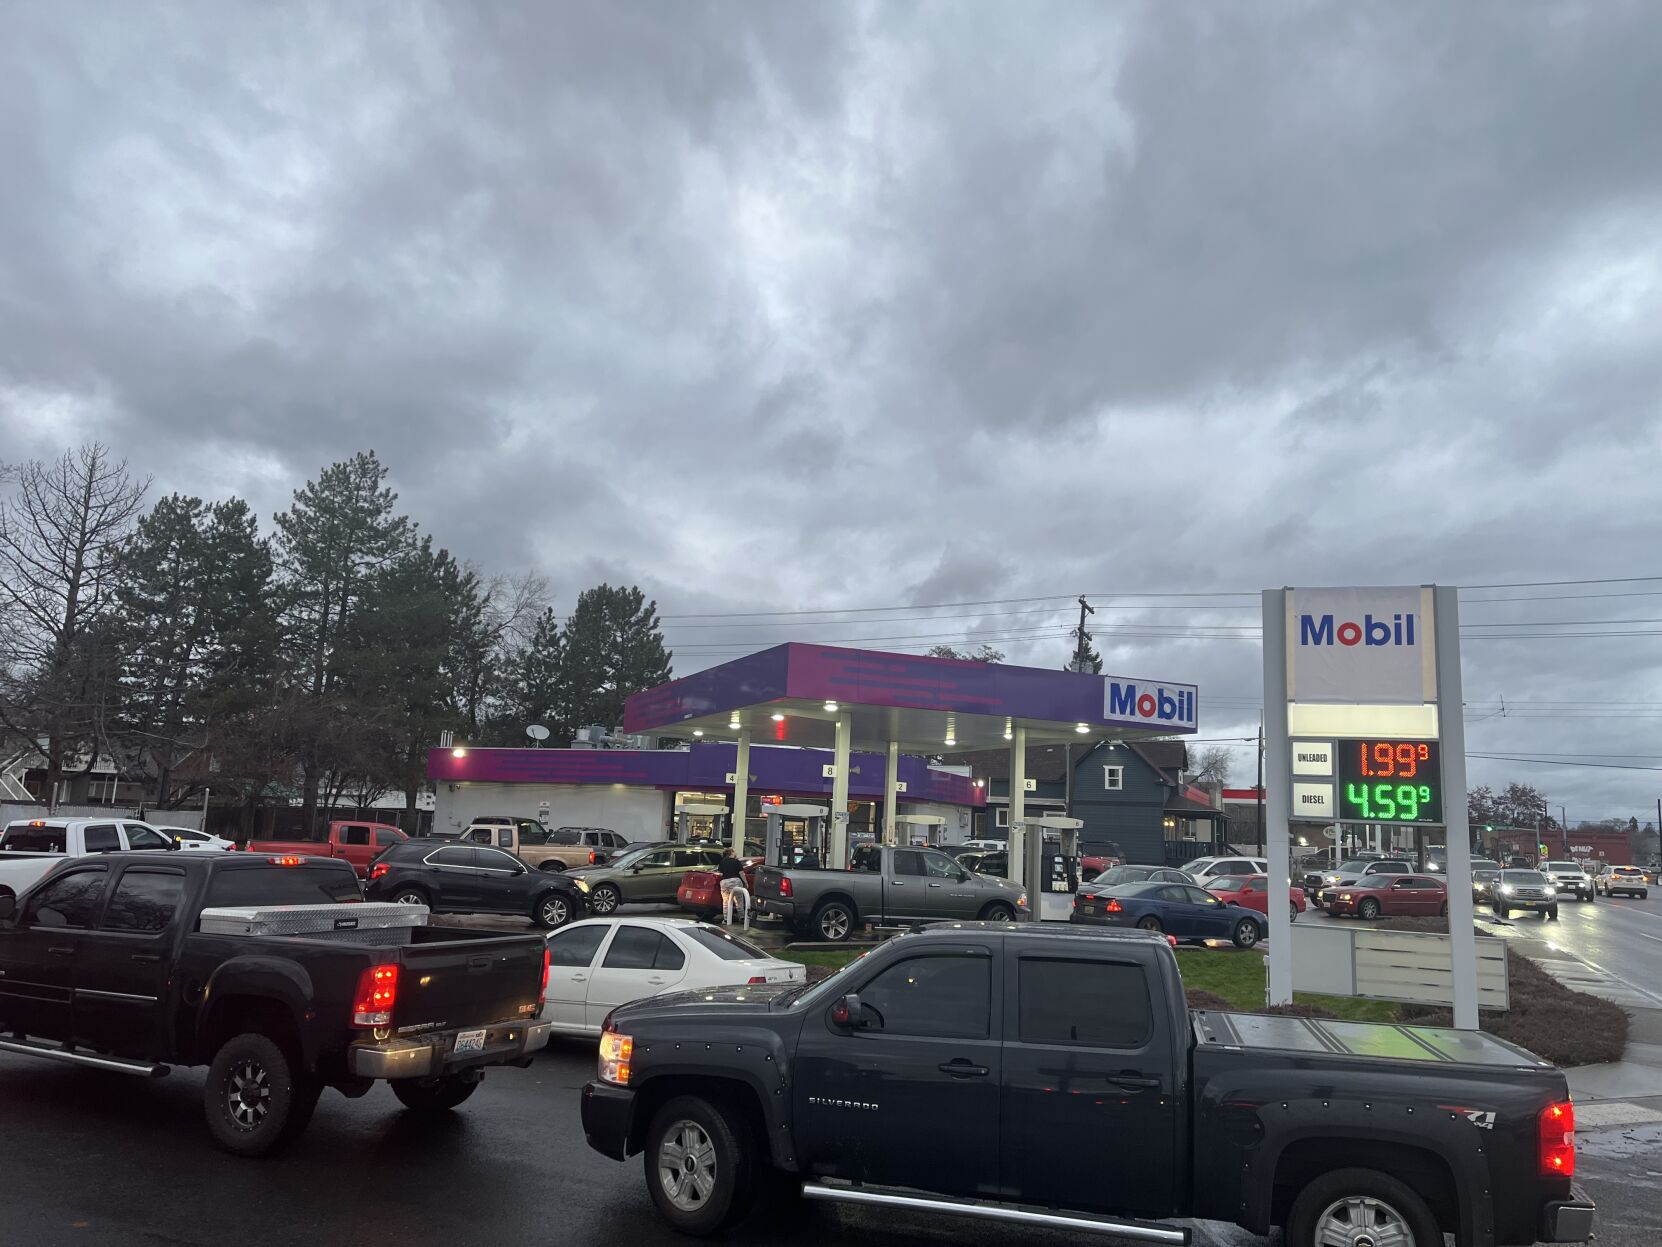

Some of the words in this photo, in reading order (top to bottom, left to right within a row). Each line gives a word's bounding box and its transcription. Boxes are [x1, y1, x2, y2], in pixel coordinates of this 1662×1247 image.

[1301, 614, 1414, 646] Mobil
[1110, 683, 1192, 722] Mobil
[1298, 753, 1328, 763] UNLEADED
[827, 767, 833, 775] 8
[1302, 795, 1324, 804] DIESEL
[809, 1097, 878, 1111] SILVERADO
